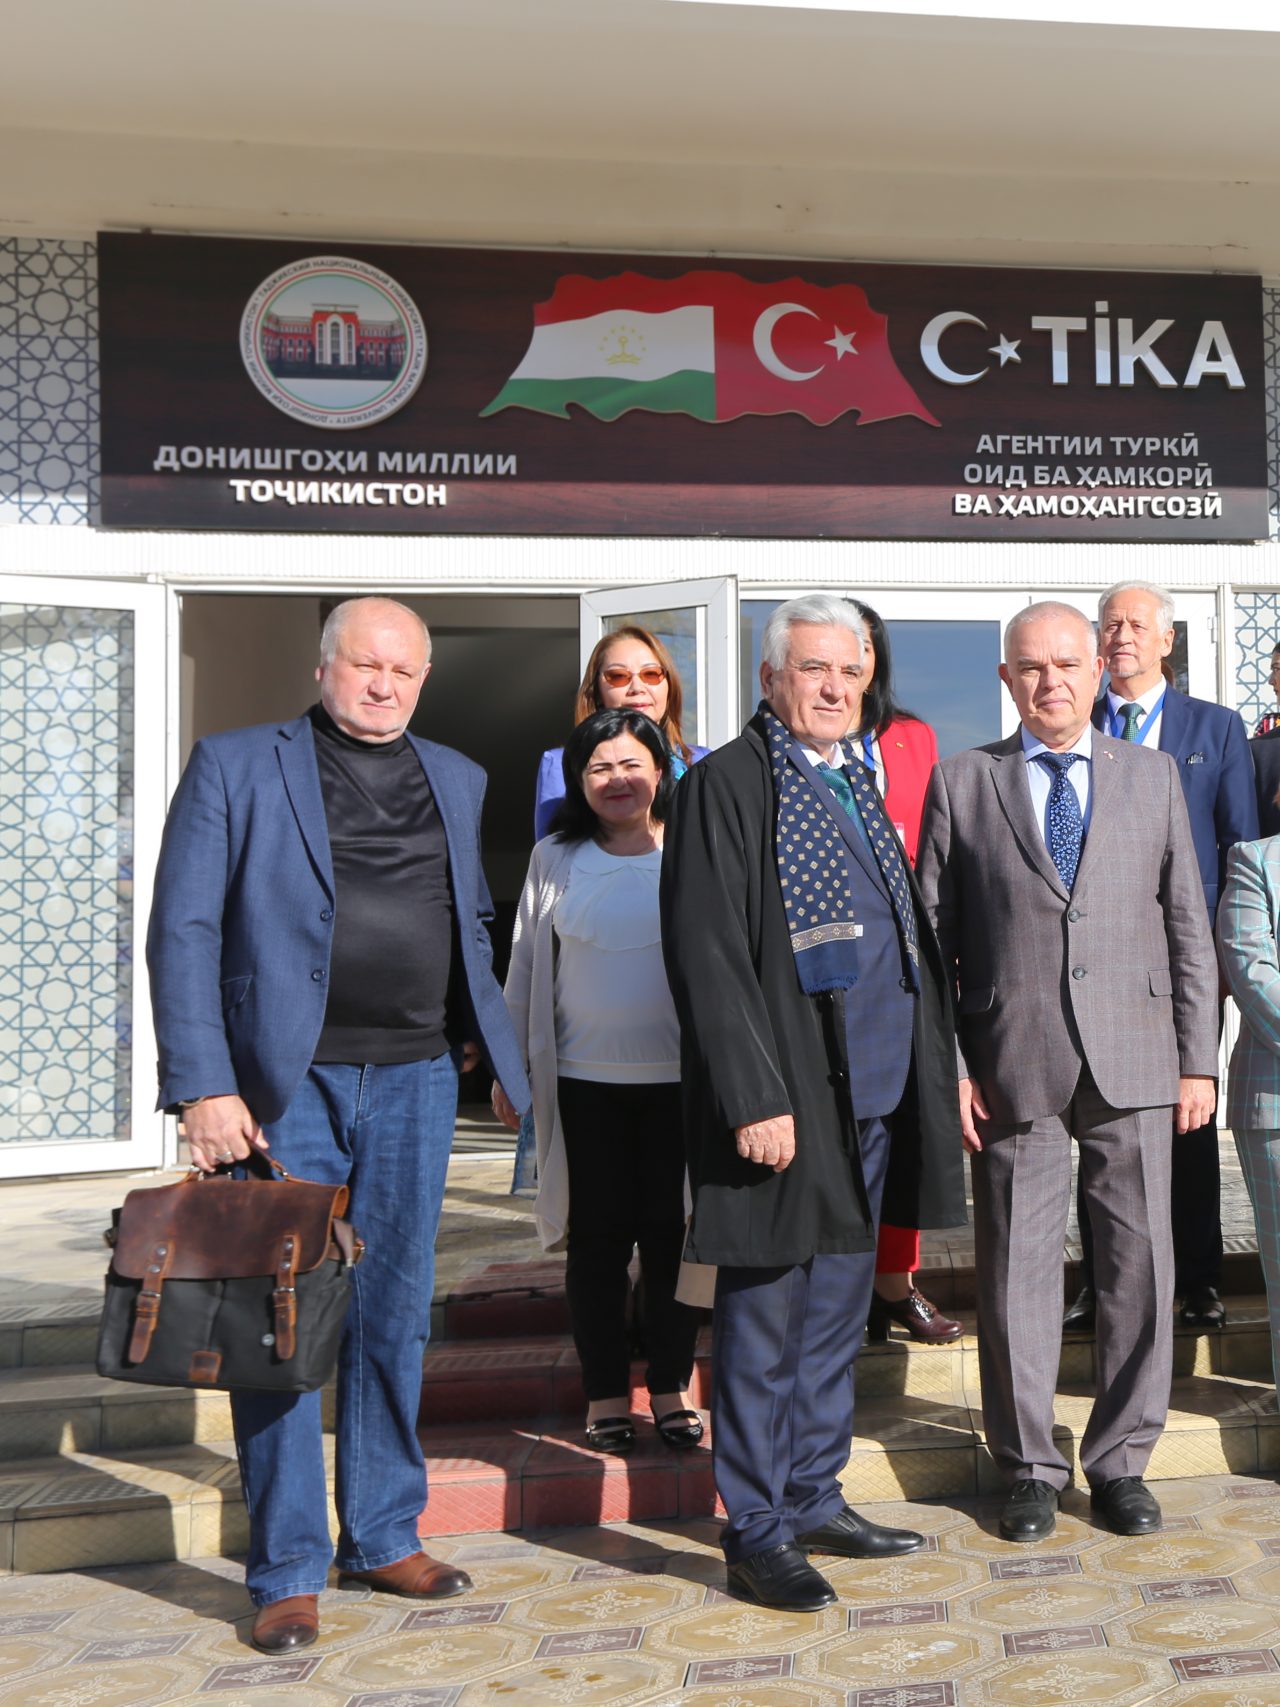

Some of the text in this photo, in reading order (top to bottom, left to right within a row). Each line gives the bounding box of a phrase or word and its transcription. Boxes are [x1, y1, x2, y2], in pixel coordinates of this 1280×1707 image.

[1032, 301, 1246, 389] TİKA
[387, 372, 417, 408] NATIONAL
[336, 404, 386, 423] UNIVERSITY
[976, 434, 1102, 456] АГЕНТИИ
[154, 445, 516, 476] ДОНИШГОҲИ МИЛЛИИ
[964, 464, 1026, 488] ОИД
[1034, 466, 1070, 485] БА
[231, 480, 446, 506] ТОҶИКИСТОН
[955, 494, 992, 514] ВА
